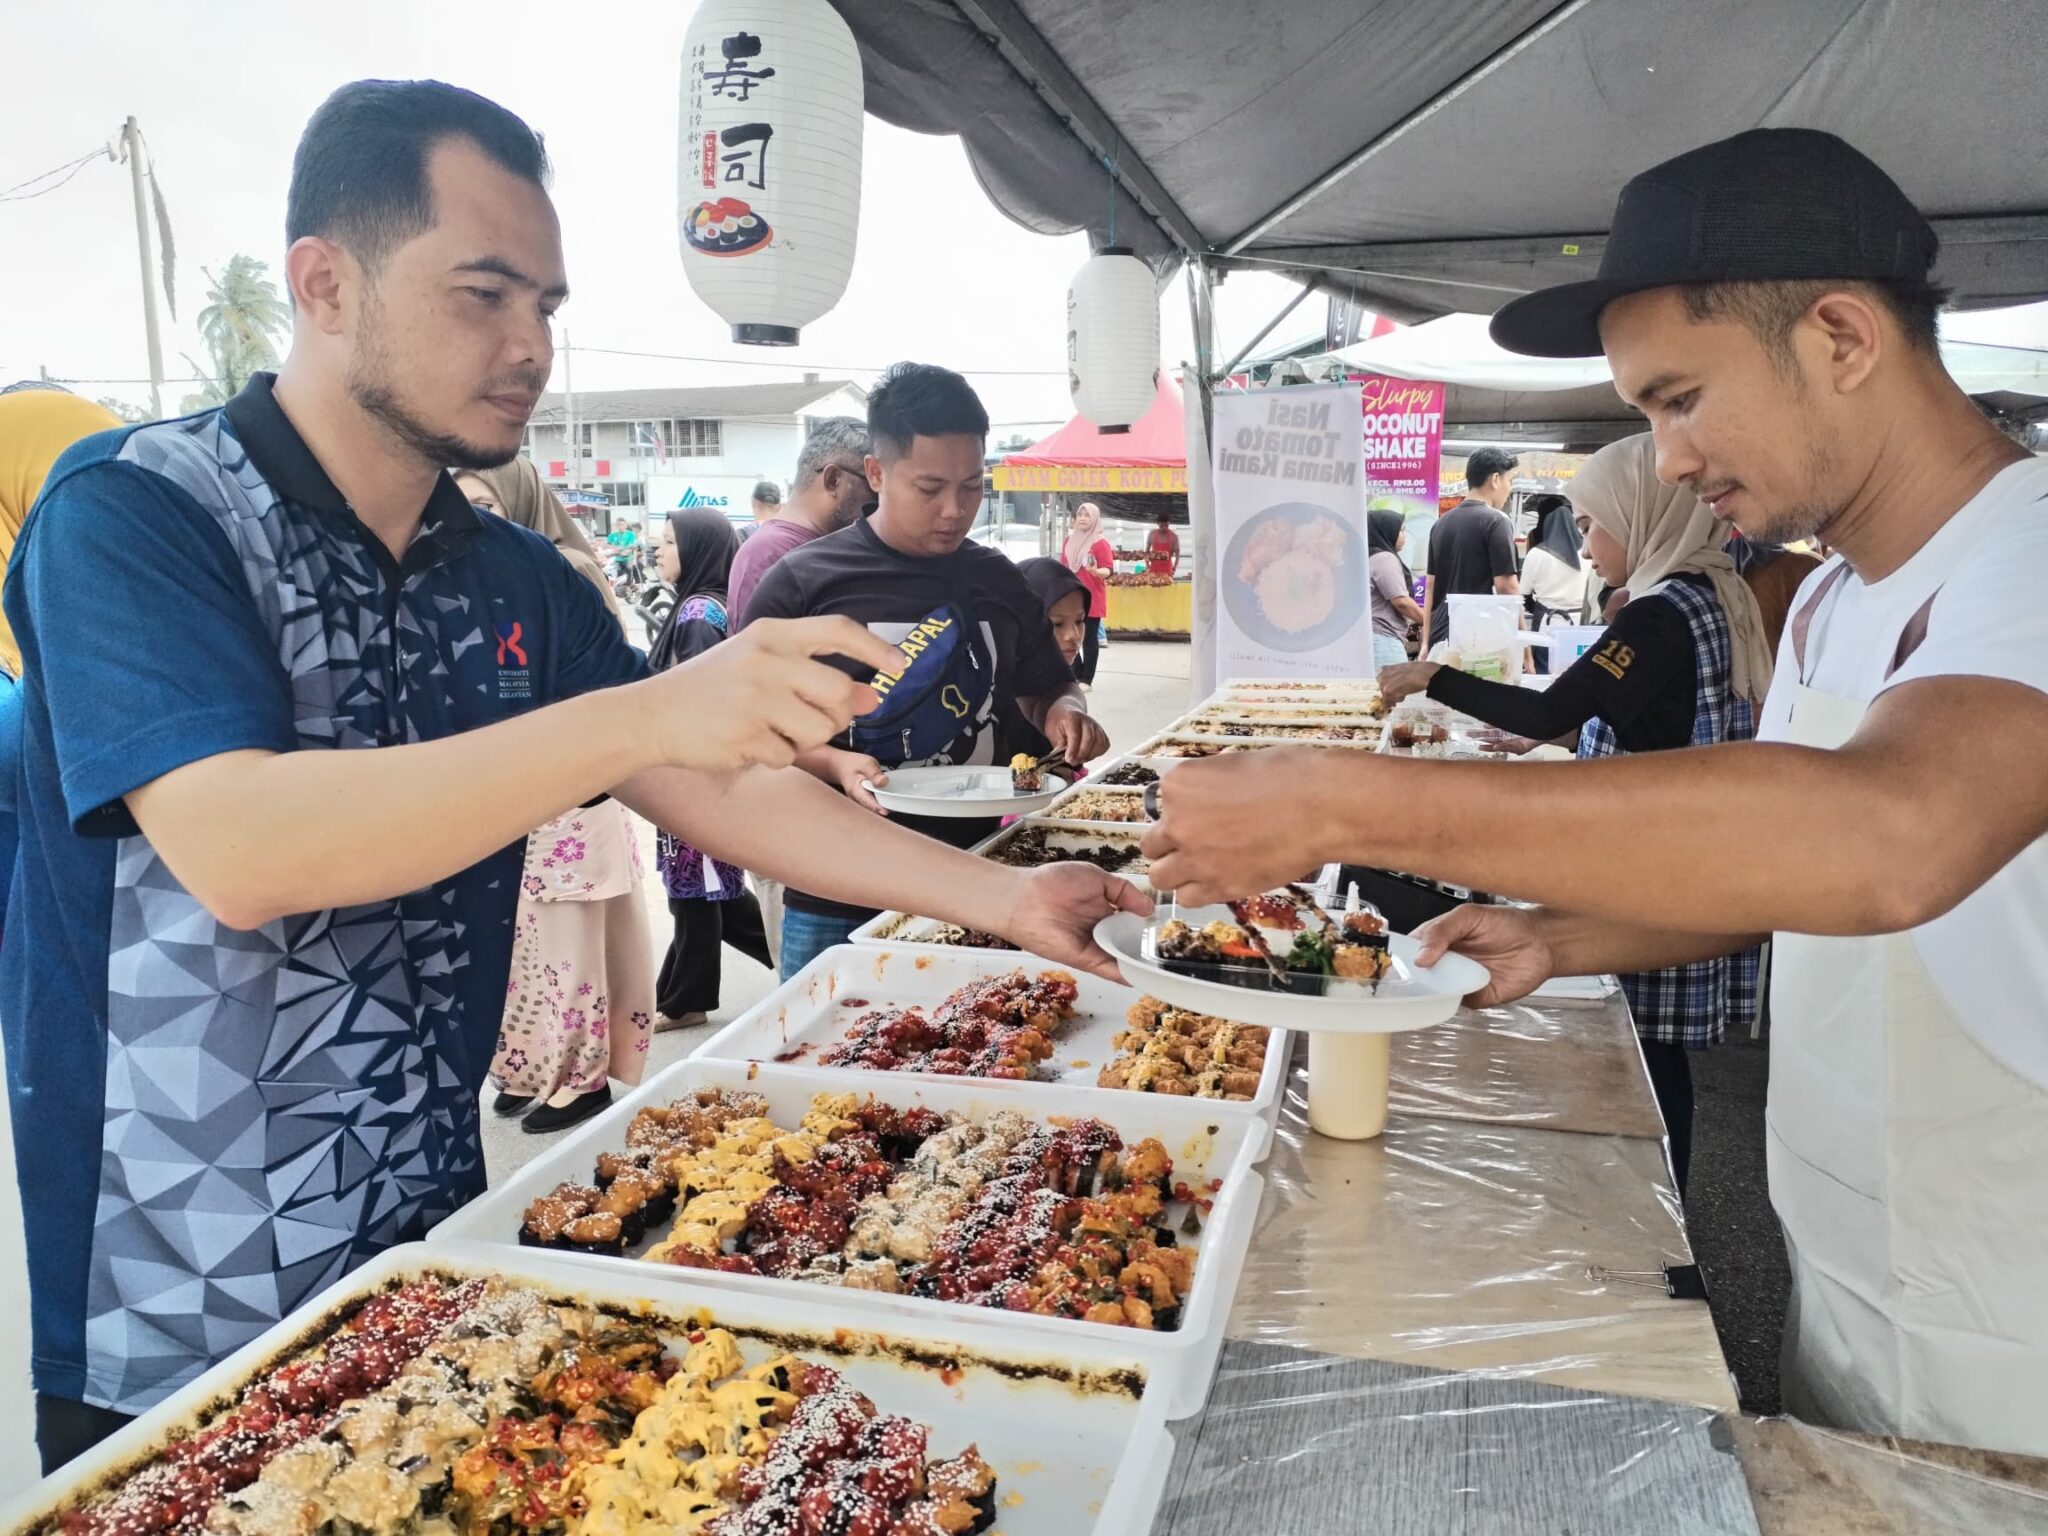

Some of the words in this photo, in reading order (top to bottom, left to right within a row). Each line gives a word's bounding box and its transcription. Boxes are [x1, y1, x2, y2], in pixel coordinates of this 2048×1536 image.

[1361, 379, 1434, 416] Slurpy
[1363, 412, 1440, 436] OCONUT
[1364, 437, 1427, 459] SHAKE
[1007, 469, 1050, 488] AYAM
[1057, 469, 1109, 488] GOLEK
[1120, 469, 1163, 488] KOTA
